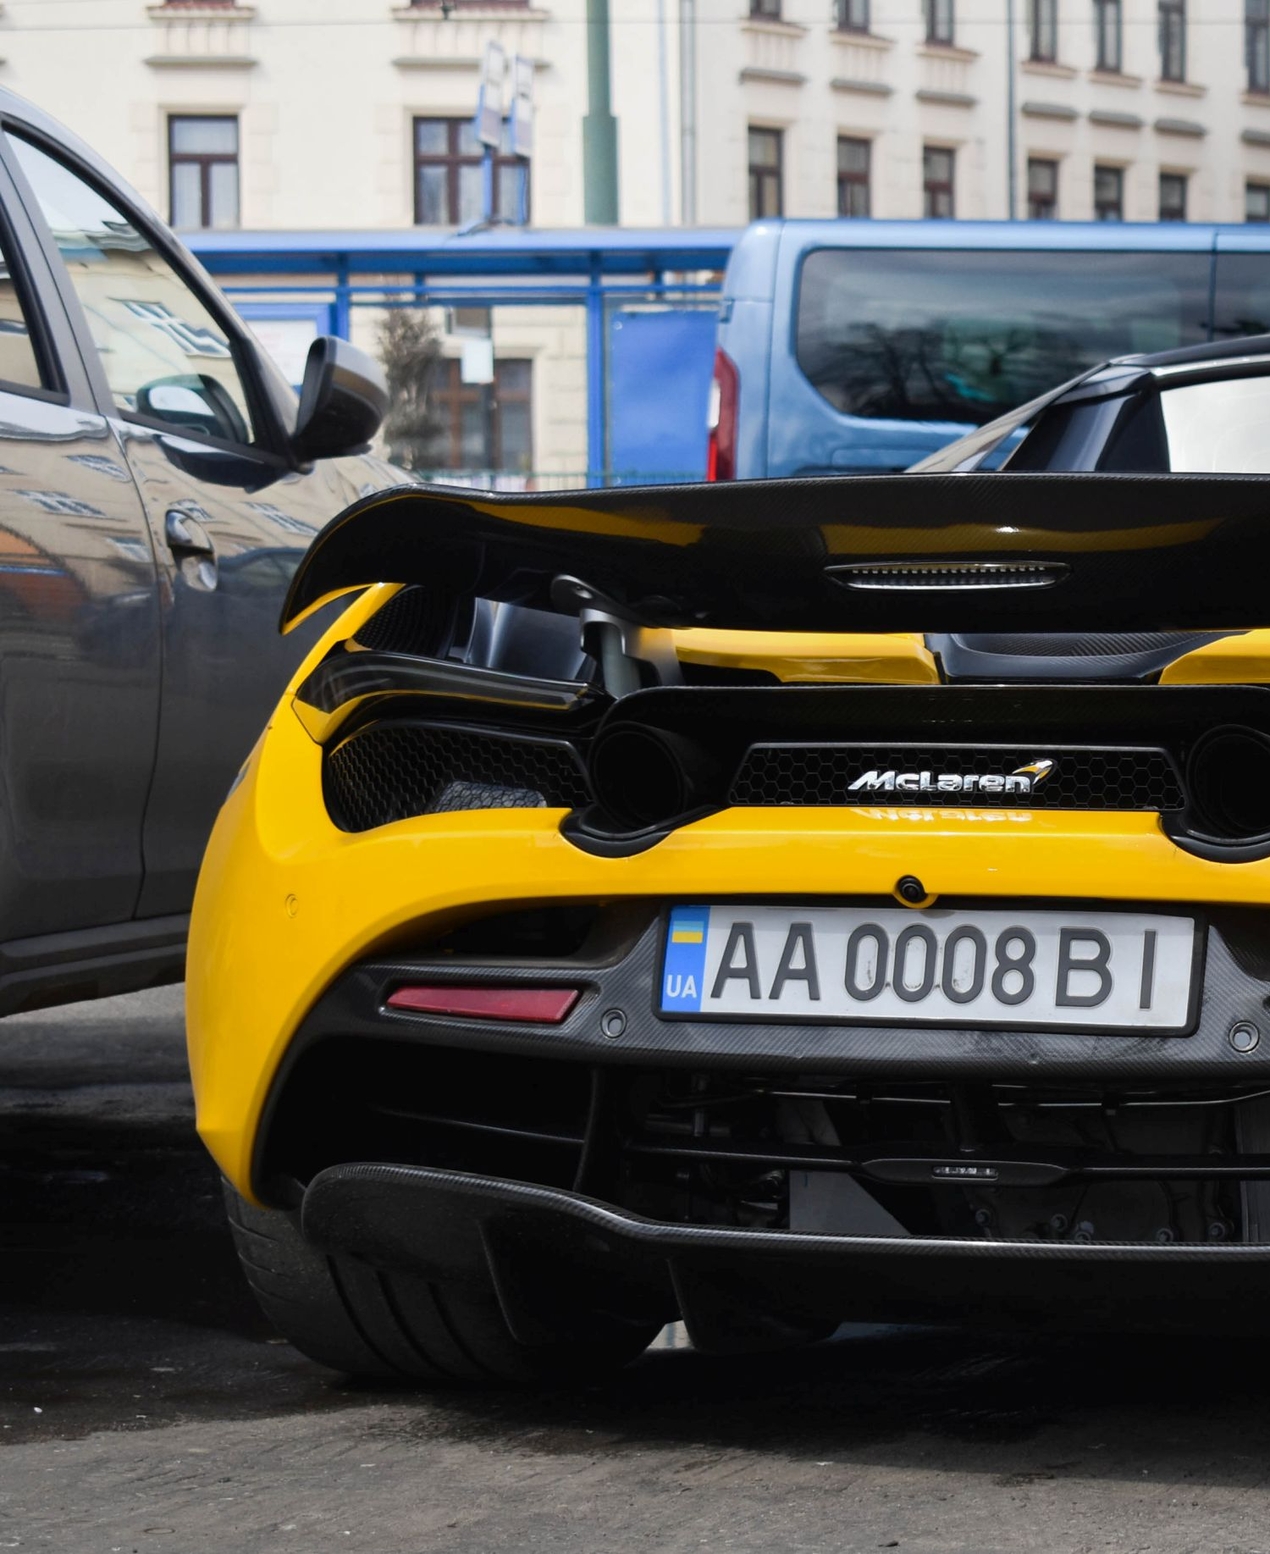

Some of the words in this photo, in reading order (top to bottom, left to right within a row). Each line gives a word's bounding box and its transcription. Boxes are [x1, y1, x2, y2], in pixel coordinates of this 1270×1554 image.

[847, 770, 1031, 793] McLaren
[710, 921, 821, 1001] AA
[844, 923, 1036, 1006] 0008
[1055, 927, 1157, 1010] BI
[665, 974, 698, 999] UA
